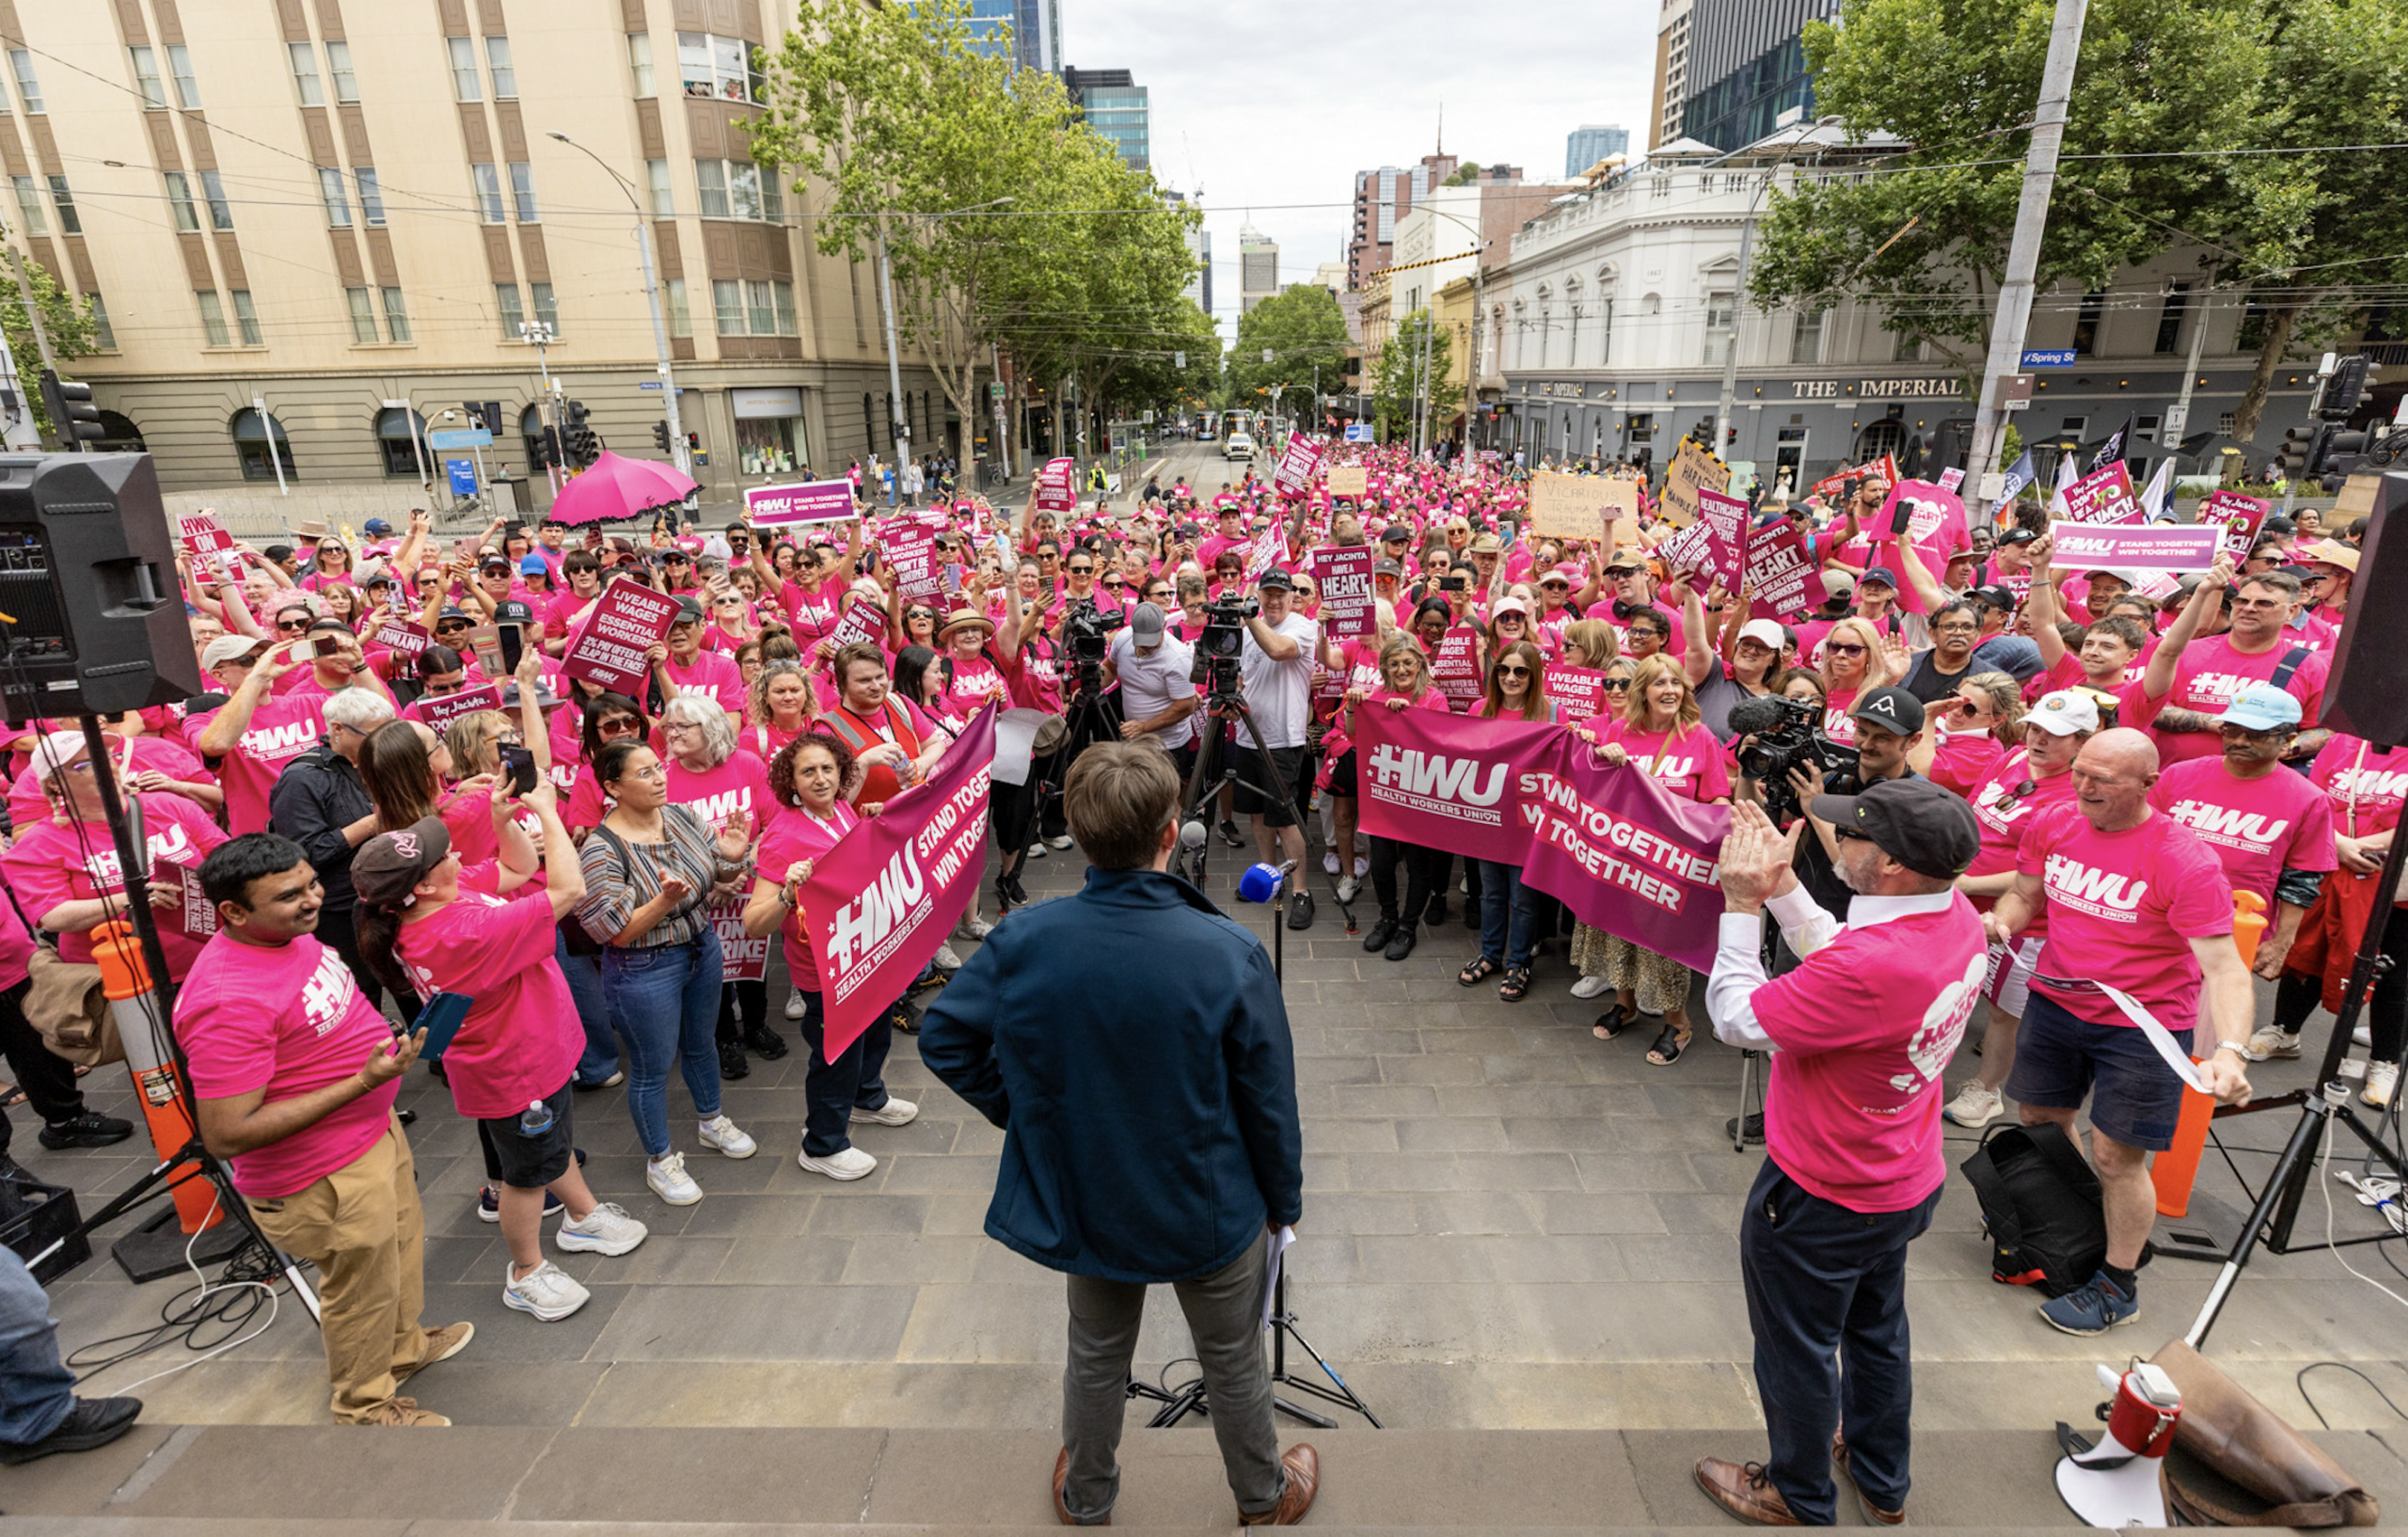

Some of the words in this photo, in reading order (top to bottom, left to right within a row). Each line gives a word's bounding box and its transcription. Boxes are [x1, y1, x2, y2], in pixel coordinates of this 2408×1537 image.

[2030, 353, 2062, 364] Spring
[2064, 352, 2075, 361] St
[1793, 381, 1837, 397] THE
[1860, 379, 1963, 397] IMPERIAL
[2175, 414, 2178, 422] 1
[1682, 464, 1703, 489] HARD
[816, 494, 848, 502] TOGETHER
[1544, 480, 1620, 501] VICARIOUS
[1666, 487, 1691, 514] HANDLE
[753, 498, 791, 512] HWU
[810, 501, 843, 510] TOGETHER
[1700, 497, 1745, 520] HEALTHCARE
[1910, 509, 1940, 523] EART
[2085, 495, 2134, 524] RINCH
[181, 516, 215, 535] HWU
[195, 533, 218, 552] ON
[1749, 525, 1790, 549] JACINTA
[2056, 536, 2116, 551] HWU
[919, 556, 929, 567] BE
[1317, 554, 1333, 563] HEY
[1334, 551, 1368, 562] JACINTA
[1750, 545, 1771, 564] HAVE
[1769, 542, 1779, 552] A
[1332, 564, 1348, 575] HAVE
[1348, 563, 1354, 573] A
[1744, 544, 1800, 587] HEART
[1322, 574, 1368, 596] HEART
[1762, 563, 1814, 596] HEALTHCARE
[612, 589, 671, 615] LIVEABLE
[1764, 579, 1805, 604] WORKERS
[615, 601, 658, 623] WAGES
[1333, 597, 1374, 610] HEALTHCA
[1776, 594, 1806, 612] HWU
[853, 603, 881, 627] JACINTA
[1338, 621, 1361, 631] HWU
[597, 623, 653, 648] WORKERS
[598, 613, 657, 640] ESSENTIAL
[377, 628, 425, 652] ANYMO
[583, 636, 598, 648] 3%
[596, 639, 612, 652] PAY
[611, 642, 636, 658] OFFER
[1439, 646, 1465, 656] WAGES
[578, 645, 600, 659] SLAP
[601, 651, 610, 661] IN
[609, 654, 624, 667] THE
[622, 658, 646, 673] FACE!
[1548, 673, 1601, 687] LIVEABLE
[1552, 683, 1592, 696] WAGES
[240, 719, 316, 753] HWU
[1366, 743, 1509, 807] HWU
[1520, 772, 1577, 814] STND
[918, 802, 958, 859] STAND
[953, 759, 993, 816] TOGET
[1370, 786, 1407, 803] HEALTH
[1409, 797, 1461, 816] WORKERS
[1464, 808, 1501, 823] UNION
[2167, 800, 2289, 843] HWU
[931, 847, 962, 891] WIN
[960, 806, 988, 861] TOGE
[2195, 832, 2240, 846] WORKERS
[2241, 840, 2271, 854] UNION
[1550, 817, 1682, 911] TOGETHER
[2044, 854, 2148, 910] HWU
[827, 836, 925, 976] HWU
[2060, 894, 2100, 914] WORKERS
[2102, 909, 2137, 922] UNION
[717, 920, 746, 940] ON
[720, 939, 766, 960] RIKE
[836, 962, 871, 1001] HEALTH
[873, 923, 912, 965] WORKERS
[911, 896, 933, 927] UNION
[723, 966, 742, 975] WU
[1982, 942, 2004, 999] ALTHCARE
[317, 1006, 348, 1035] HEALTH
